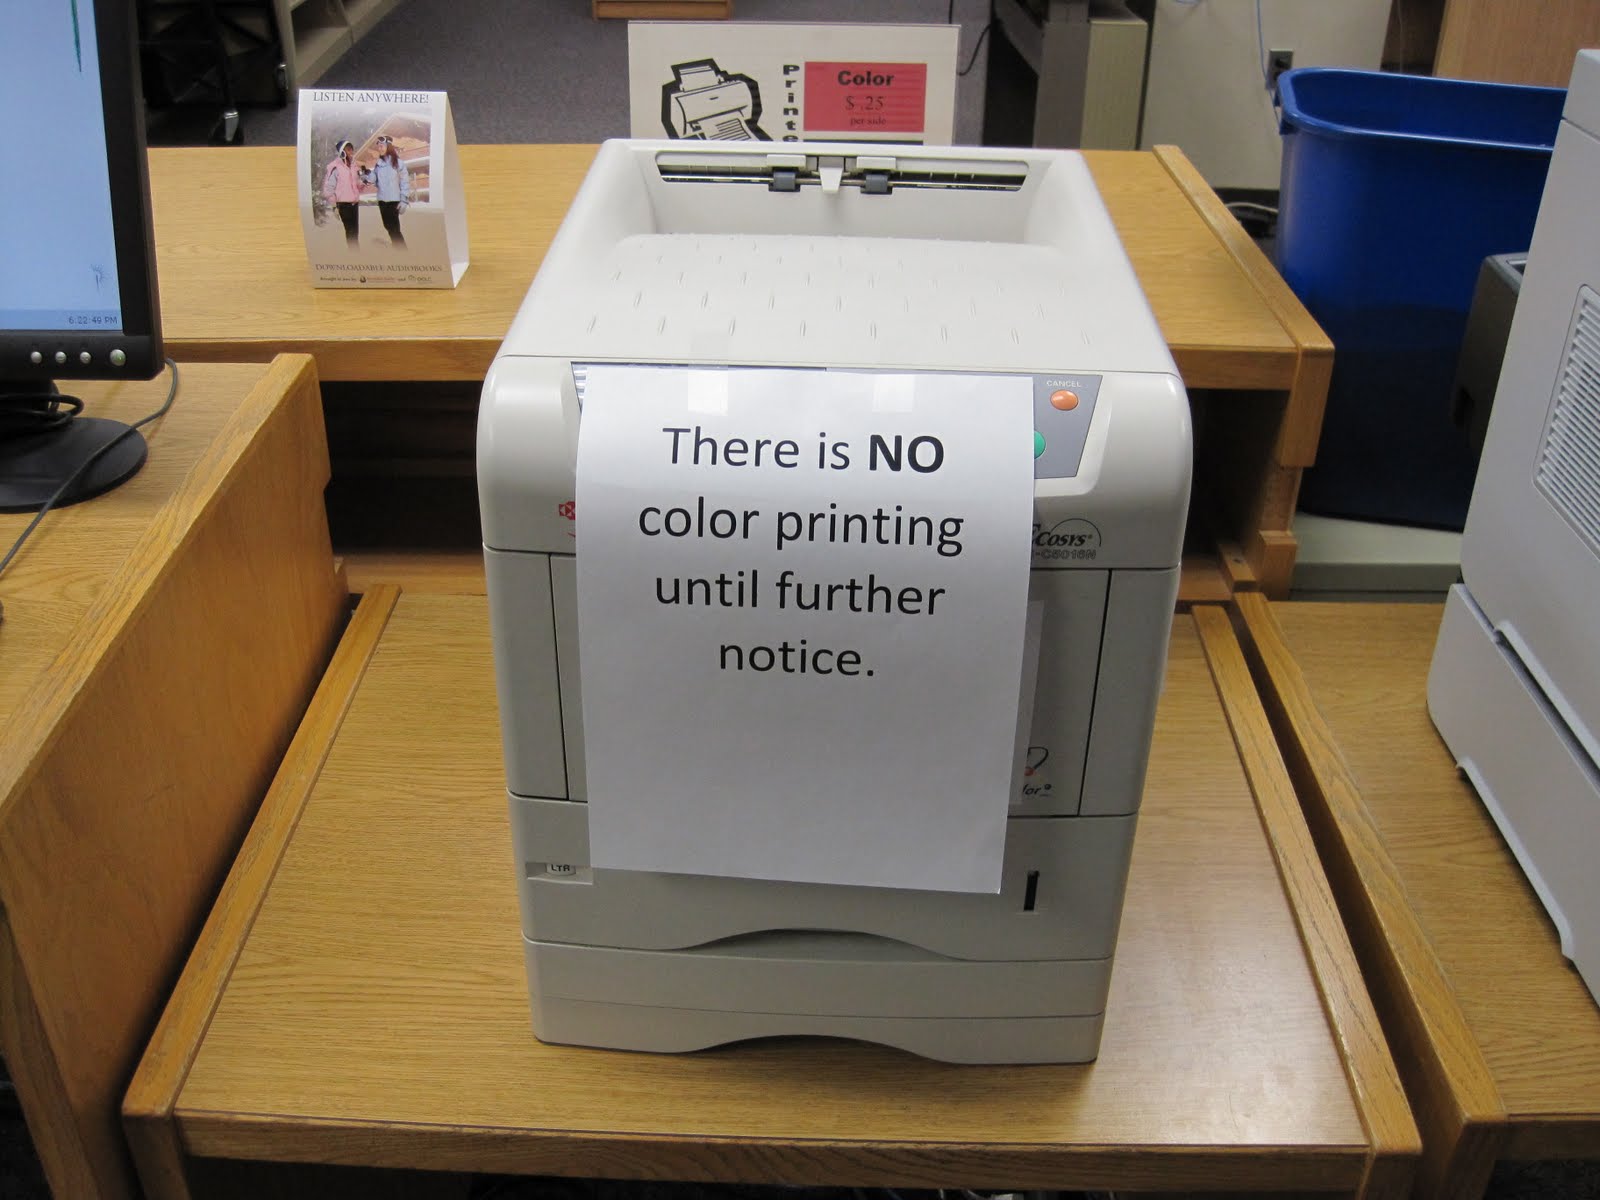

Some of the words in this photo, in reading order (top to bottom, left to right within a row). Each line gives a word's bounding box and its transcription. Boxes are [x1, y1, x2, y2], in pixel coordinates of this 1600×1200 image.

[837, 70, 894, 87] Color
[313, 91, 355, 102] LISTEN
[357, 92, 430, 104] ANYWHERE!
[845, 95, 855, 111] $
[850, 116, 864, 126] per
[868, 115, 886, 125] side
[315, 263, 383, 272] DOWNLOADABLE
[386, 264, 443, 272] AUDIOBOOKS
[68, 316, 102, 325] 6:22:49
[104, 316, 118, 324] PM
[1046, 380, 1081, 388] CANCEL
[662, 426, 800, 468] There
[818, 432, 850, 470] is
[870, 435, 943, 473] NO
[640, 497, 759, 539] color
[777, 503, 963, 557] printing
[657, 570, 757, 607] until
[776, 571, 945, 615] further
[720, 639, 873, 676] notice.
